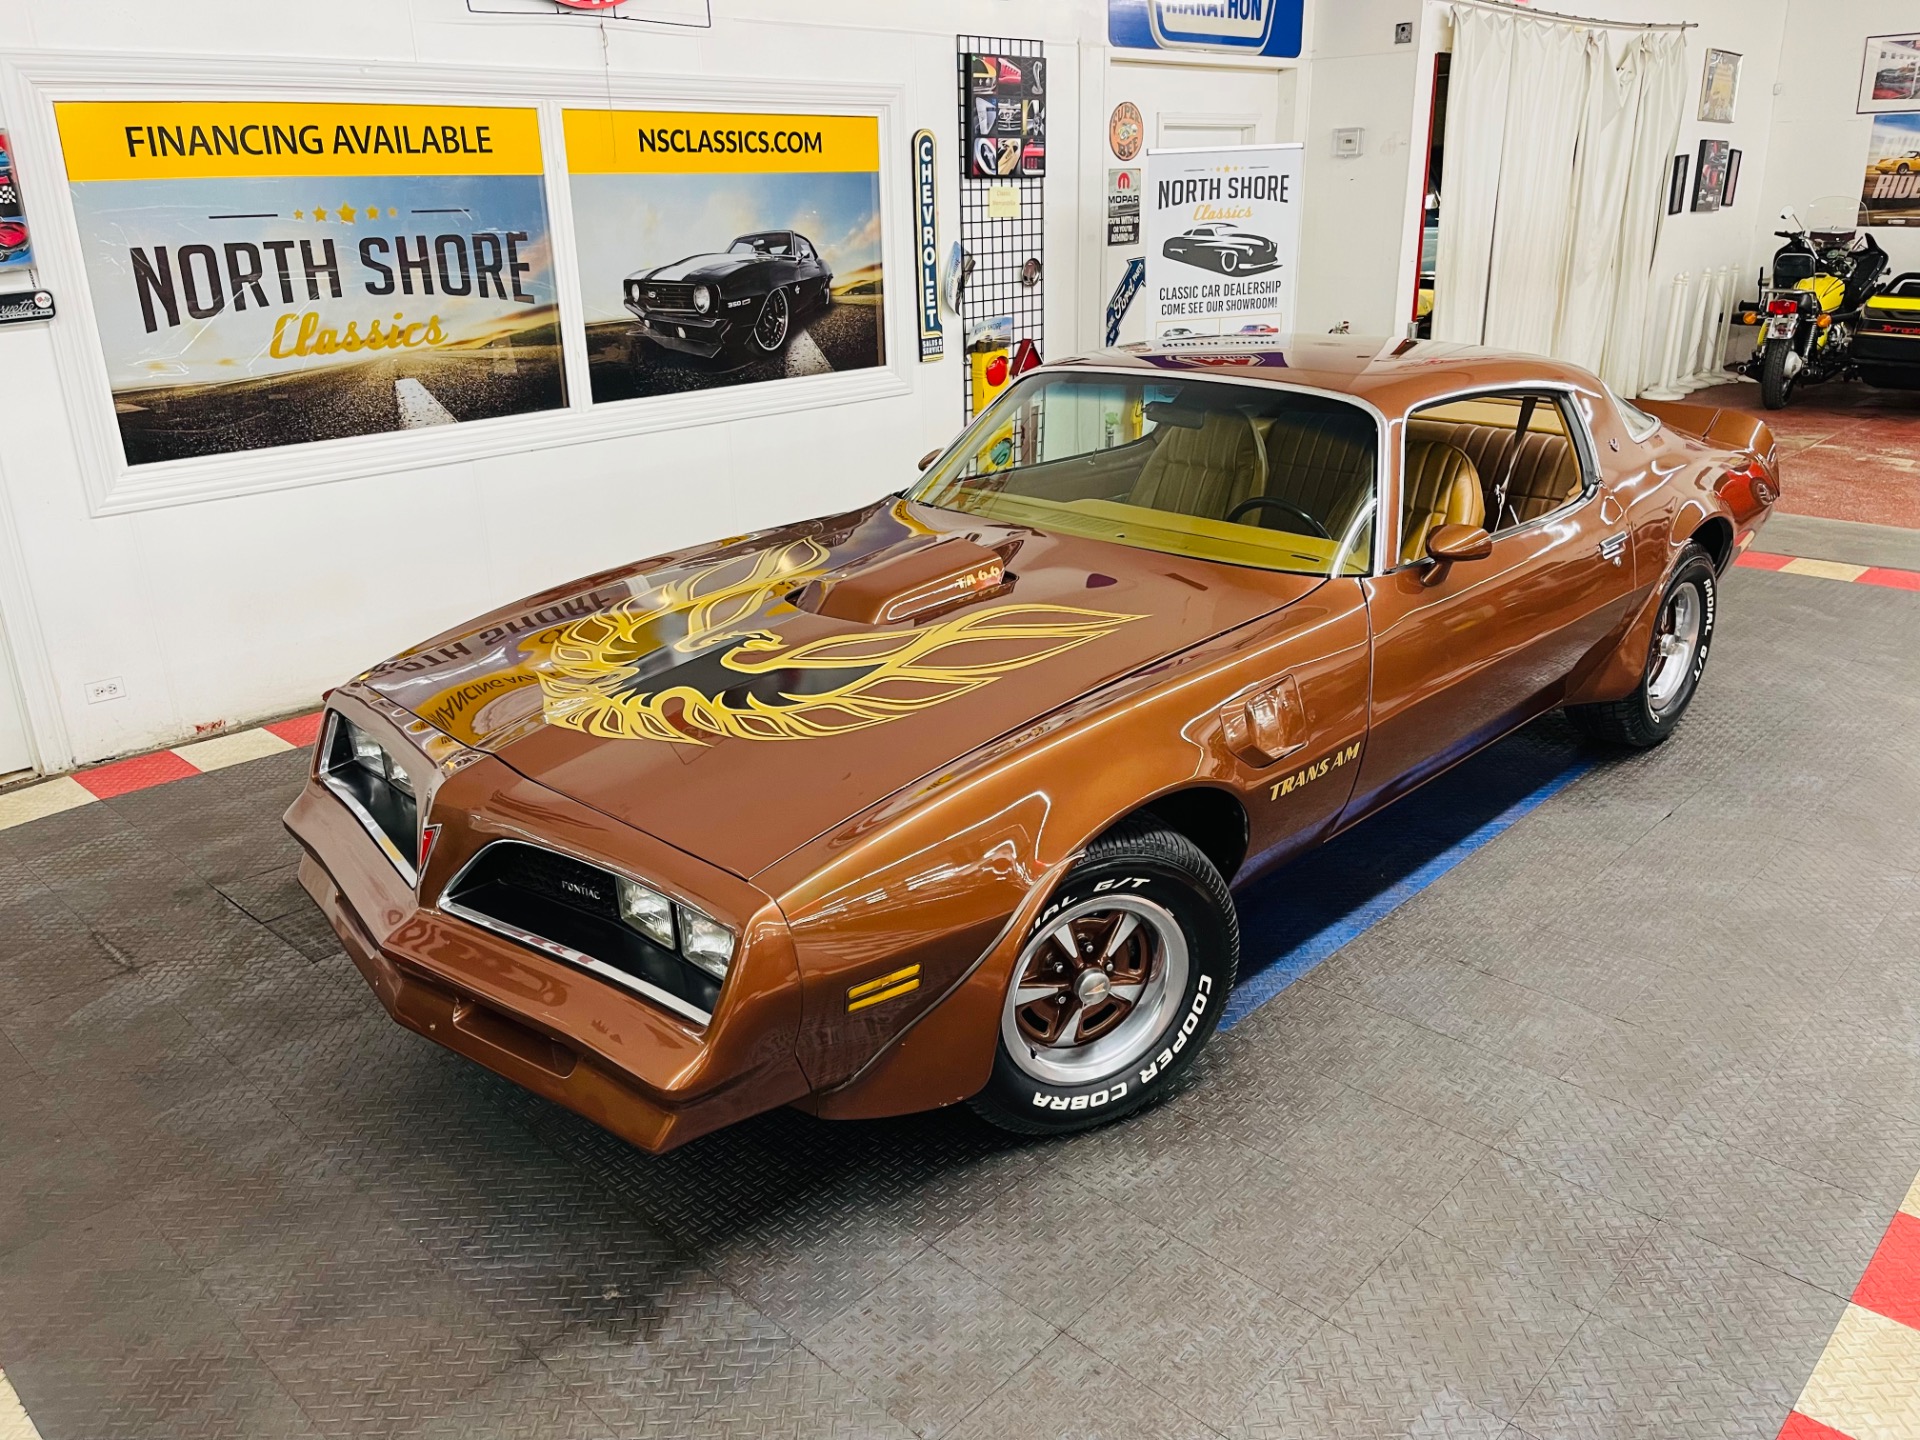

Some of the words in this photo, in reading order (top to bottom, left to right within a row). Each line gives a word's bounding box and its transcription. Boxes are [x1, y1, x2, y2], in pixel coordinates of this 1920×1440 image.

[1112, 105, 1140, 135] SUPER
[125, 125, 324, 158] FINANCING
[333, 125, 493, 155] AVAILABLE
[638, 128, 822, 154] NSCLASSICS.COM
[1117, 137, 1138, 158] BEE
[1108, 195, 1140, 204] MOPAR
[1158, 177, 1221, 210] NORTH
[1228, 174, 1290, 203] SHORE
[1192, 204, 1253, 221] Classics
[920, 140, 936, 328] CHEVROLET
[130, 239, 343, 334] NORTH
[359, 231, 535, 304] SHORE
[1159, 285, 1199, 301] CLASSIC
[1202, 284, 1220, 298] CAR
[1223, 280, 1282, 297] DEALERSHIP
[1114, 279, 1135, 319] Ford
[1161, 303, 1186, 315] COME
[1188, 301, 1204, 314] SEE
[1206, 300, 1224, 312] OUR
[1226, 297, 1278, 311] SHOWROOM!
[268, 312, 448, 360] Classics
[978, 564, 1000, 581] 6.6
[1703, 578, 1716, 637] RADIAL
[1693, 645, 1708, 682] G/T
[1269, 757, 1331, 801] TRANS
[1330, 741, 1361, 771] AM
[561, 880, 601, 900] PONTIAC
[1093, 877, 1151, 893] G/T
[1138, 974, 1213, 1084] COOPER
[1032, 1082, 1129, 1112] COBRA
